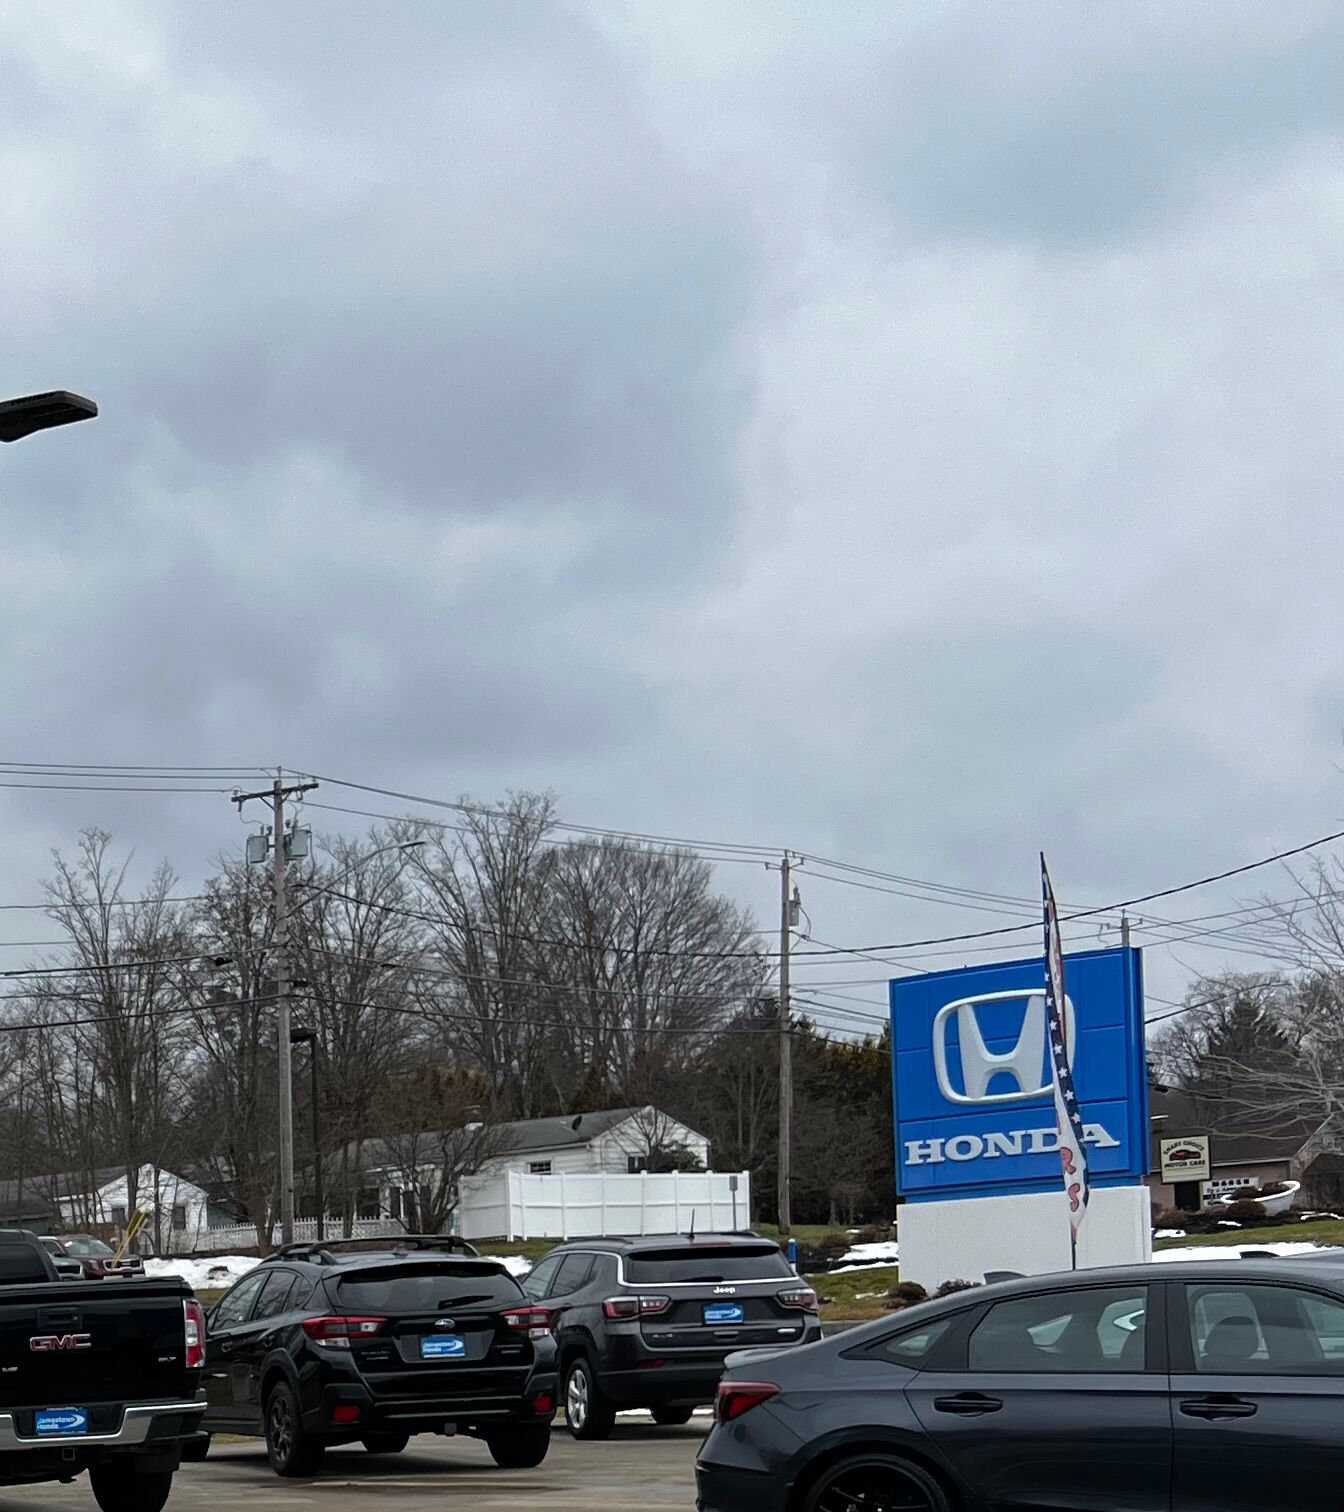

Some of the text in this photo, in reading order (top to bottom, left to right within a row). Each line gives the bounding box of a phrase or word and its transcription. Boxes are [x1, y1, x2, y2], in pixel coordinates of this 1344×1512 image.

[904, 1123, 1120, 1165] HONDA
[713, 1286, 736, 1294] Jeep
[29, 1333, 92, 1351] GMC
